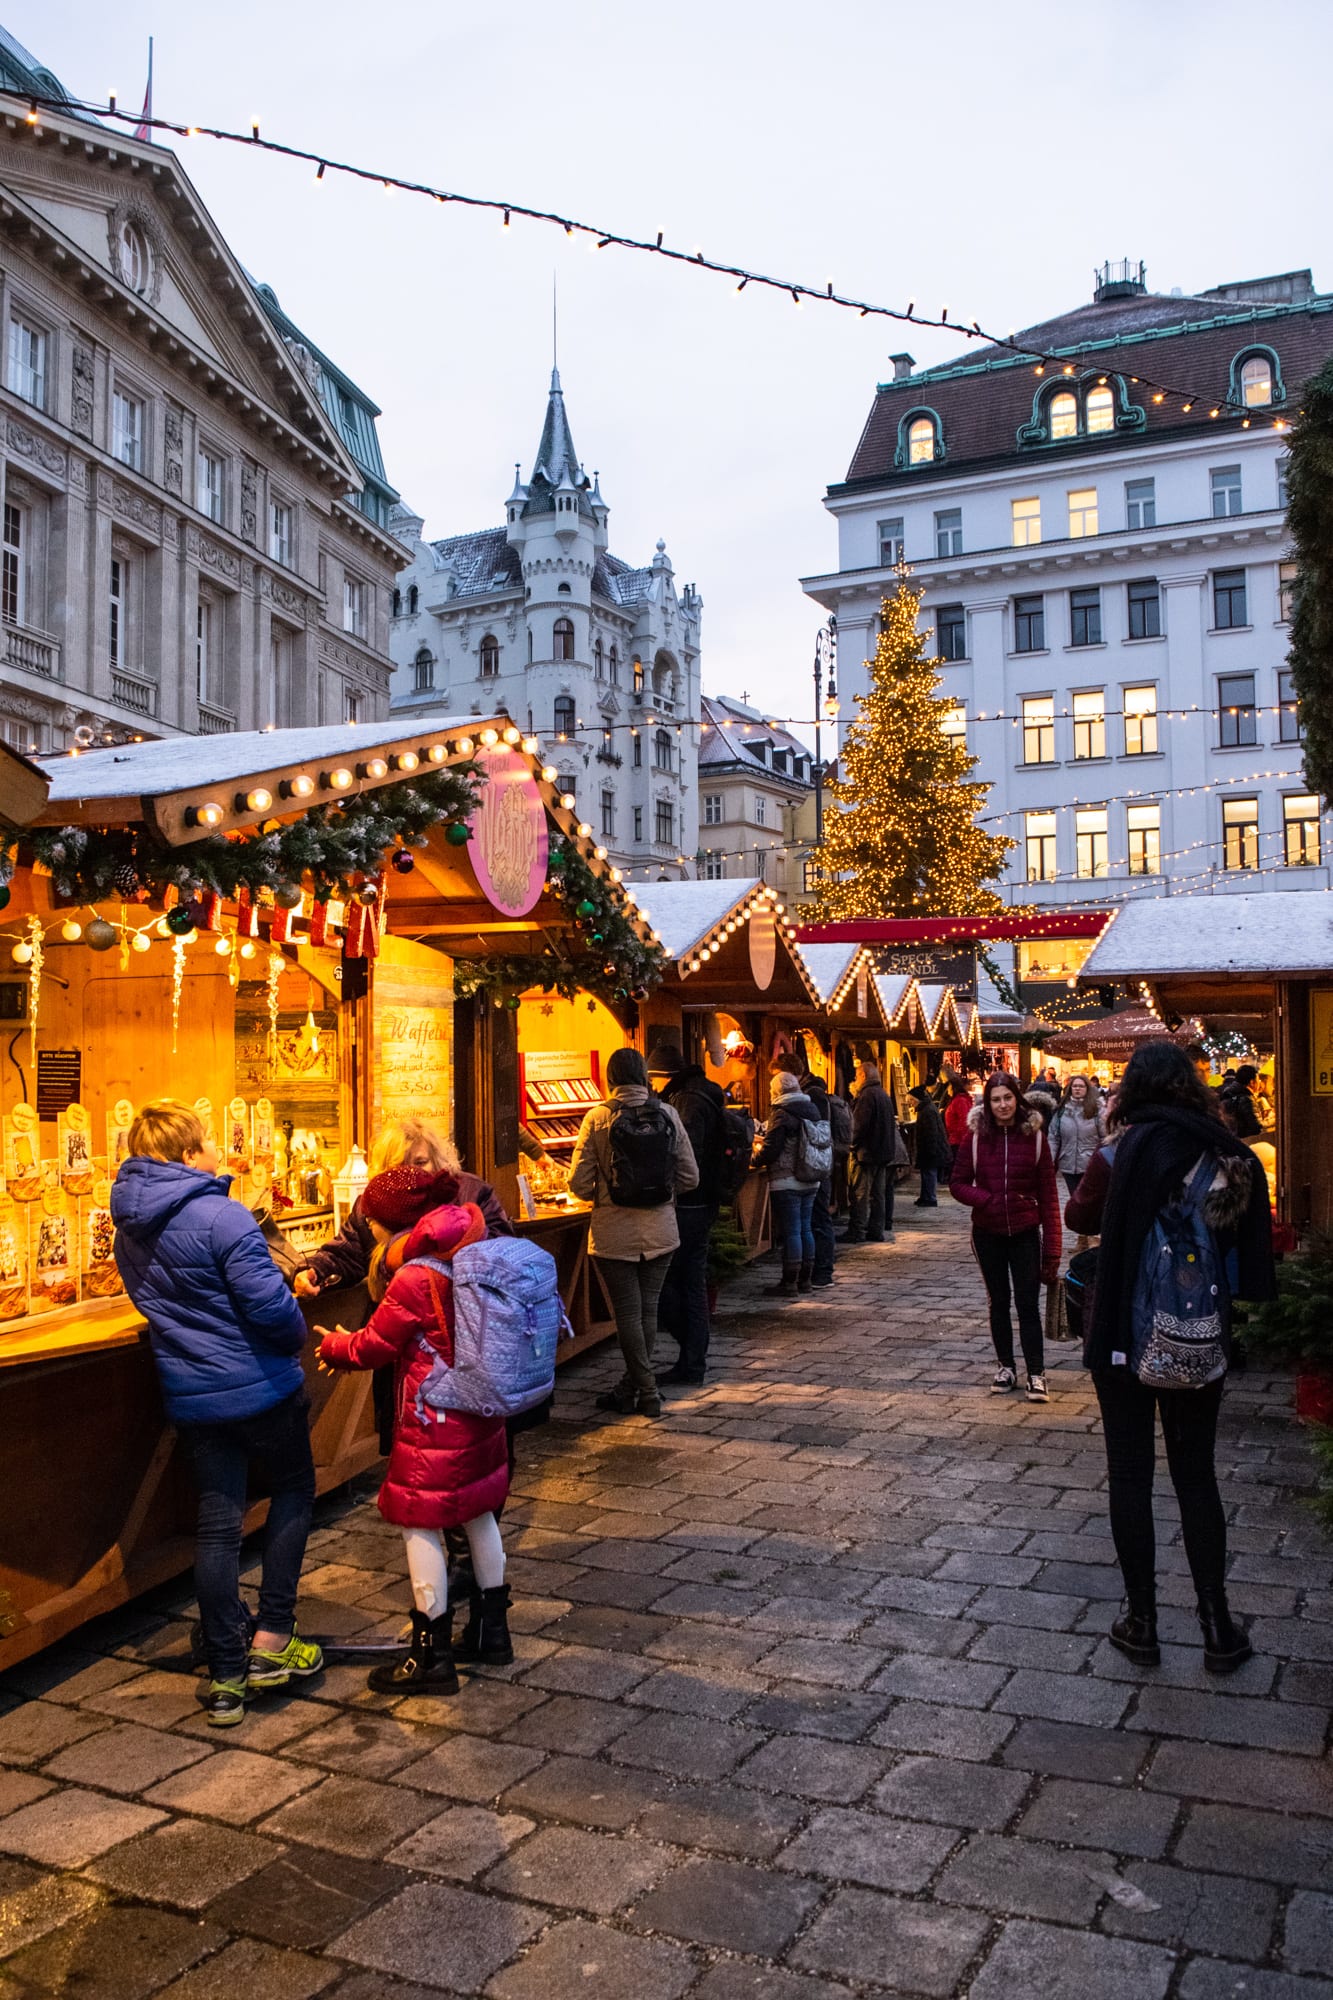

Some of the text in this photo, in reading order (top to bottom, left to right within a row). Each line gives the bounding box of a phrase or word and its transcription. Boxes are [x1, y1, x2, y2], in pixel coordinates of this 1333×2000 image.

[890, 952, 935, 966] SPECK
[887, 964, 939, 975] STANDL
[387, 1013, 447, 1049] Waffeln
[400, 1081, 433, 1094] 3,50
